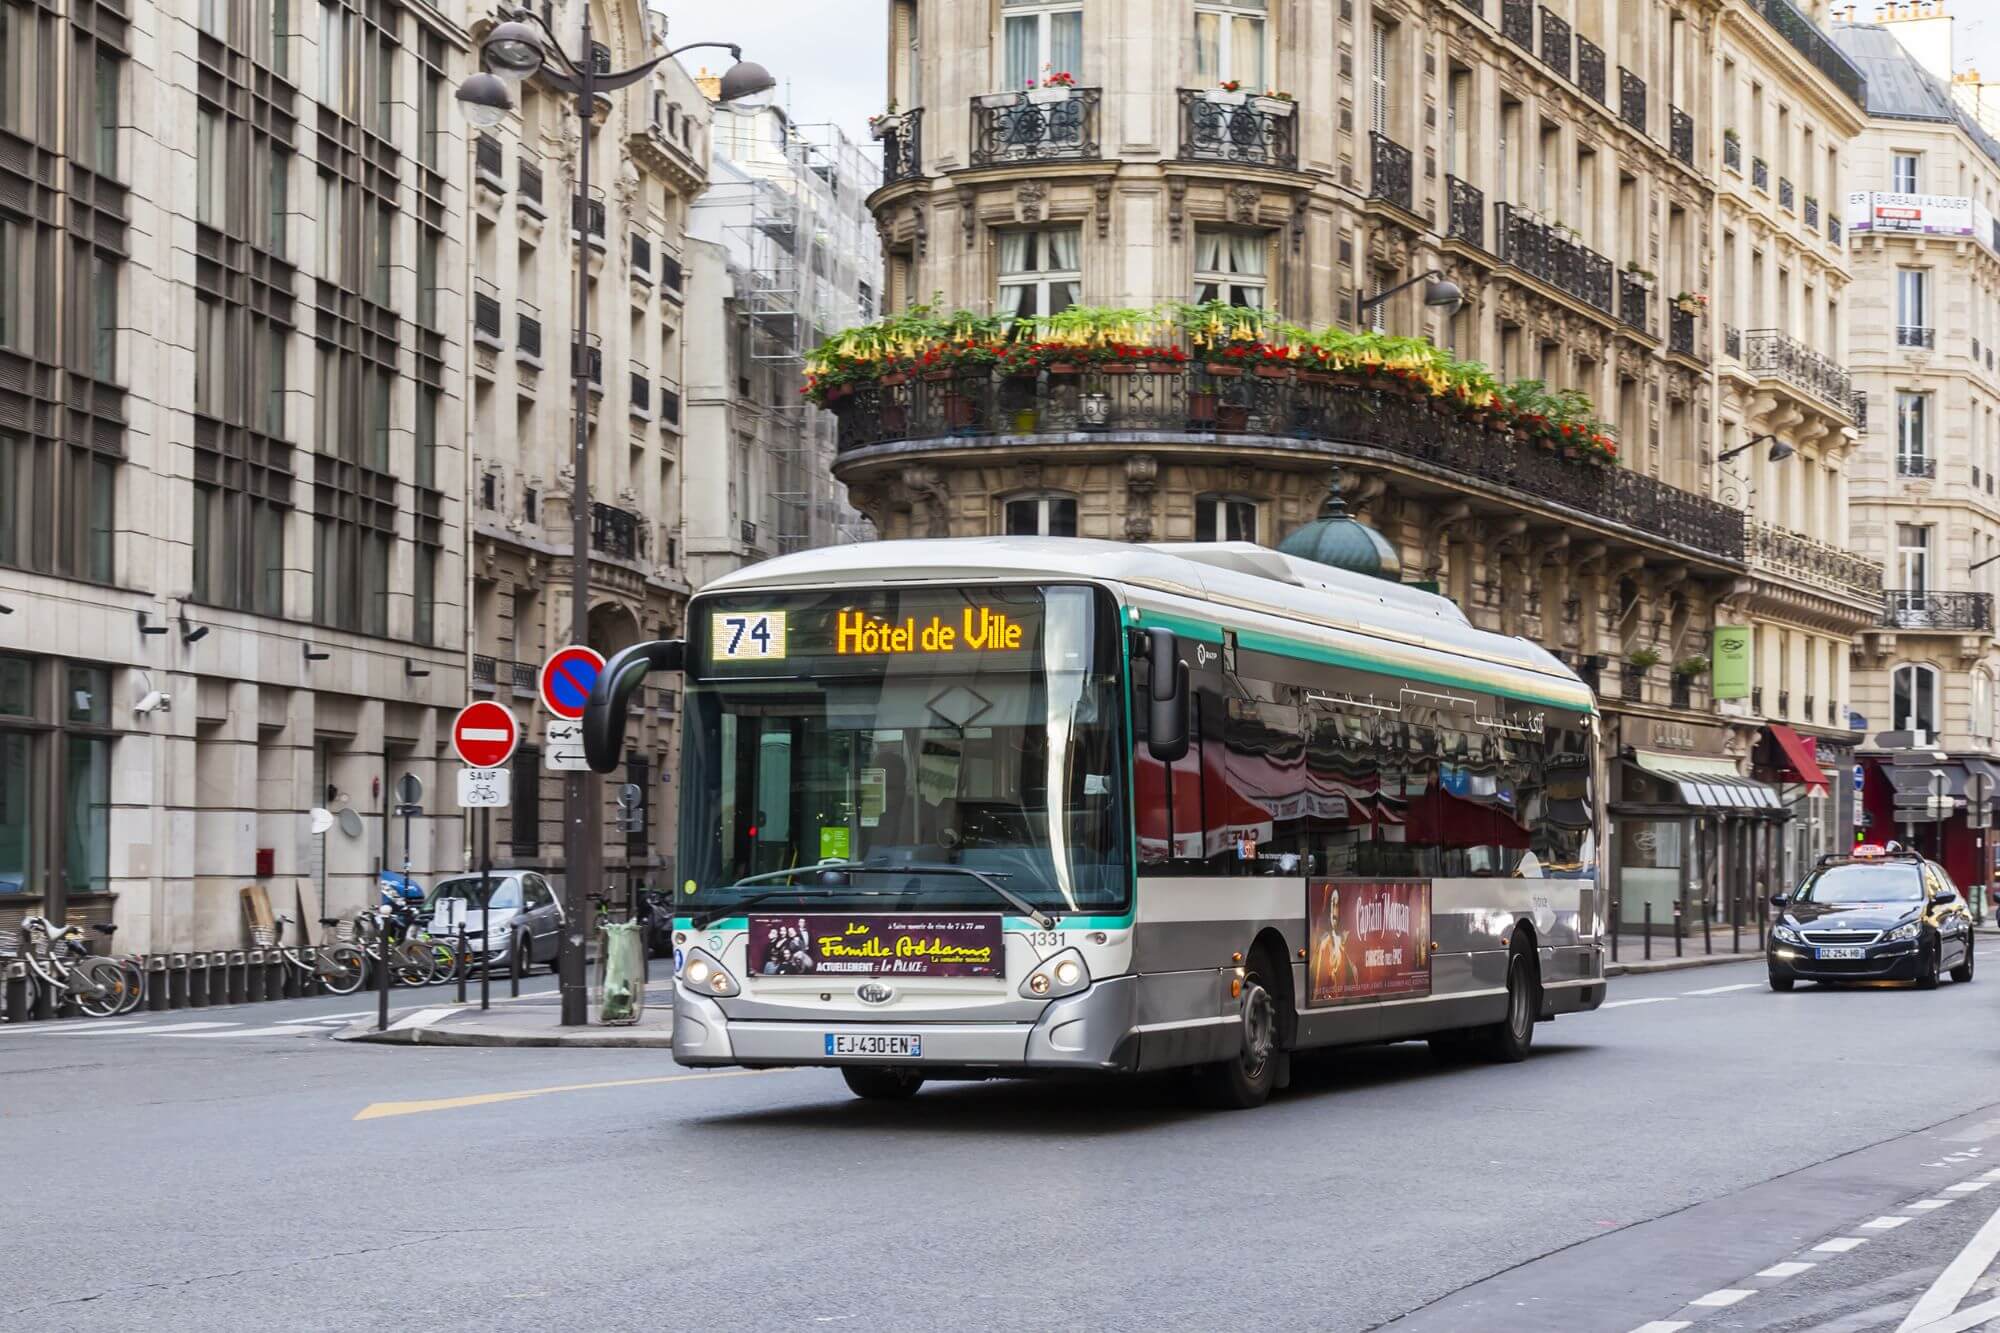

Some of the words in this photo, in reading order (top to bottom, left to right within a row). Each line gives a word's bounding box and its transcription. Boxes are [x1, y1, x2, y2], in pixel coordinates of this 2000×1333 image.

[1876, 193, 1923, 206] BUREAUX
[1935, 197, 1969, 209] LOUER
[726, 617, 771, 654] 74
[838, 611, 914, 653] Hôtel
[921, 616, 955, 651] de
[963, 607, 1023, 649] Ville
[469, 771, 497, 781] SAUF
[1356, 896, 1382, 942] Captain
[1381, 892, 1410, 940] Morgan
[844, 921, 870, 935] La
[817, 936, 893, 957] Famille
[895, 935, 991, 957] Addams
[1029, 931, 1065, 947] 1331
[816, 962, 874, 972] ACTUELLEMENT
[836, 1036, 909, 1053] EJ-430-EN
